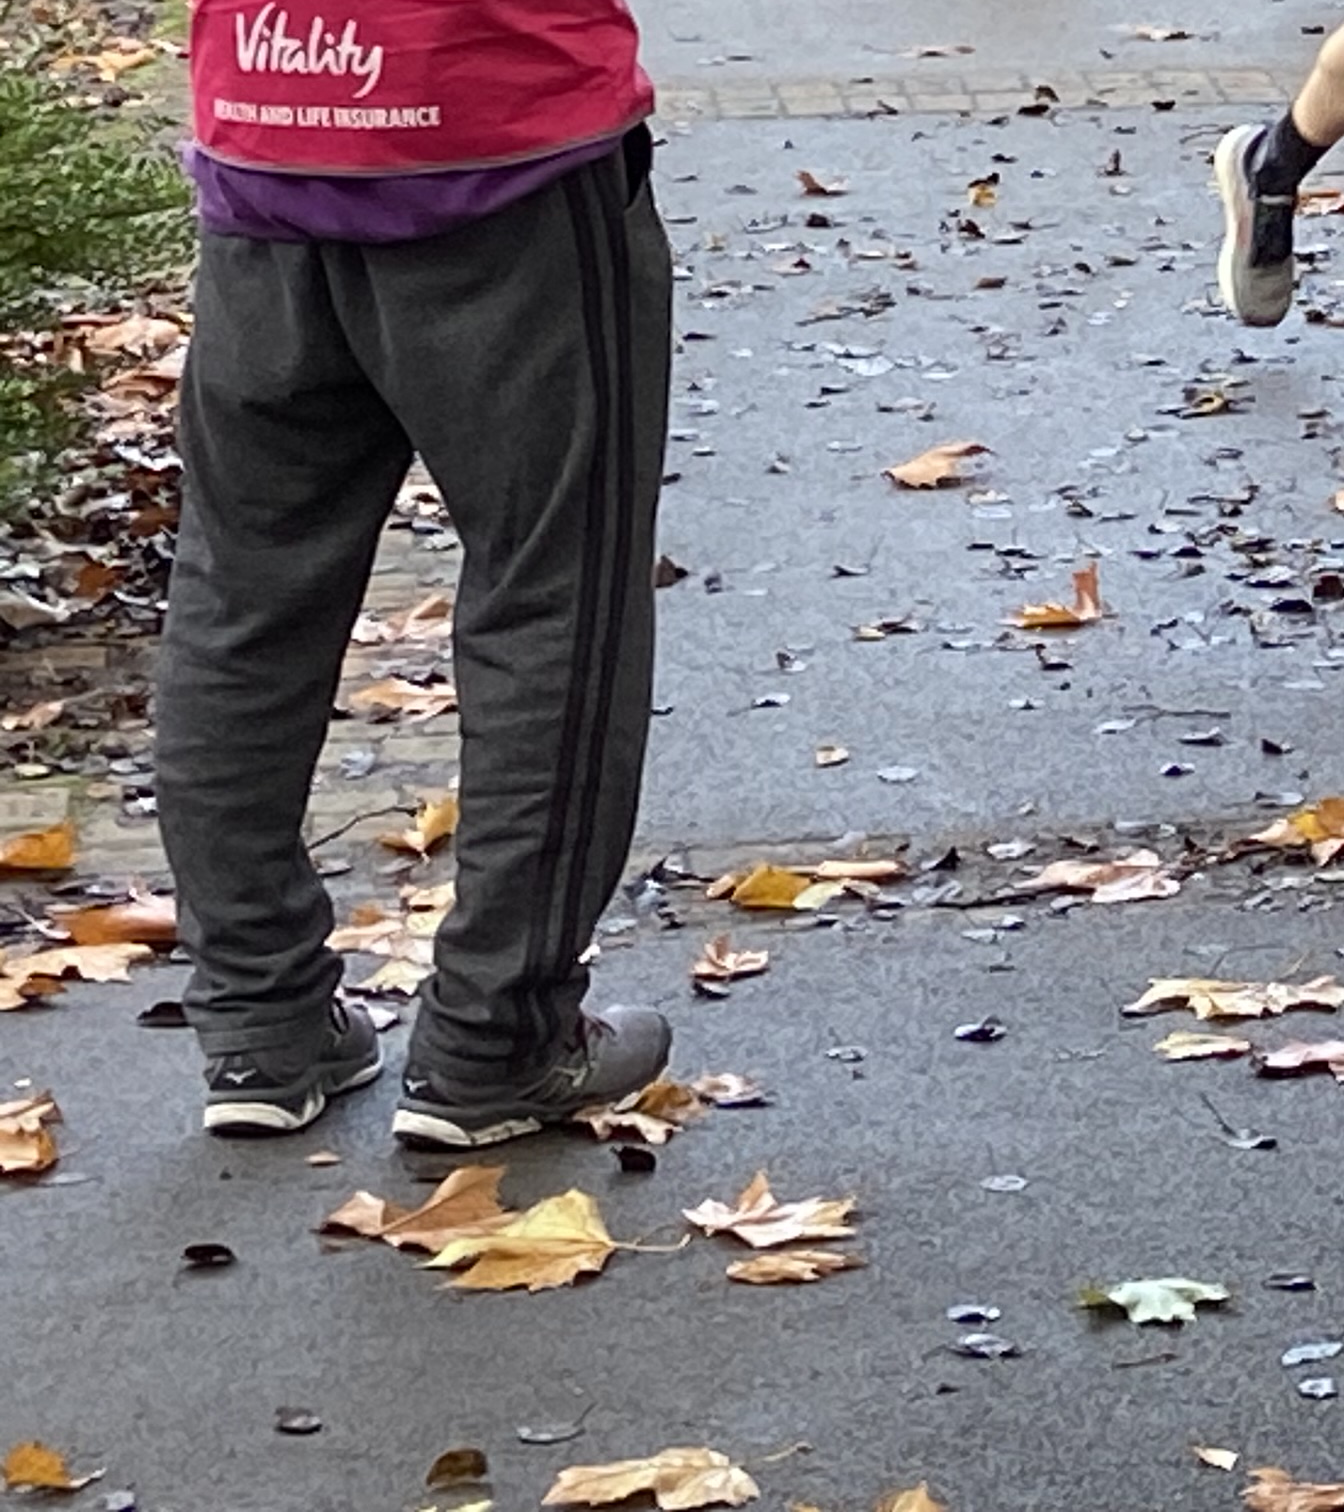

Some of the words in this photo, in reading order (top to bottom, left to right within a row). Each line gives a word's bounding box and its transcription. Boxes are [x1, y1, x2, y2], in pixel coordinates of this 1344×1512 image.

[235, 1, 384, 99] Vitality
[297, 106, 331, 128] LIFE
[333, 106, 441, 130] INSURANCE
